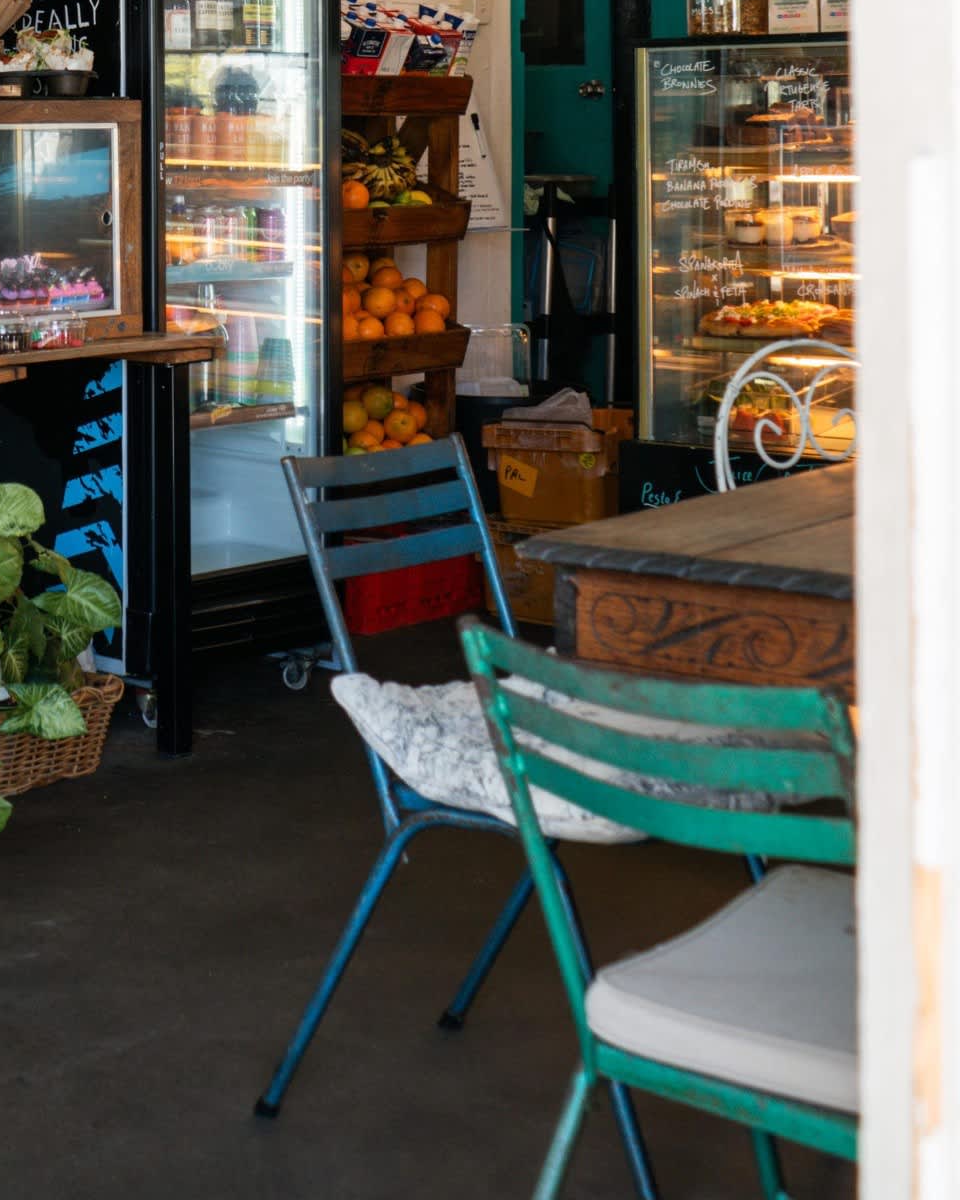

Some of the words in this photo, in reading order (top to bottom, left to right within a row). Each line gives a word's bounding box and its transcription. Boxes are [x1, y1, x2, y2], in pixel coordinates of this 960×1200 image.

[660, 60, 716, 77] CHOCOLATE
[775, 64, 820, 80] CLASSIC
[666, 179, 706, 193] BANANA
[641, 481, 670, 506] Pesto
